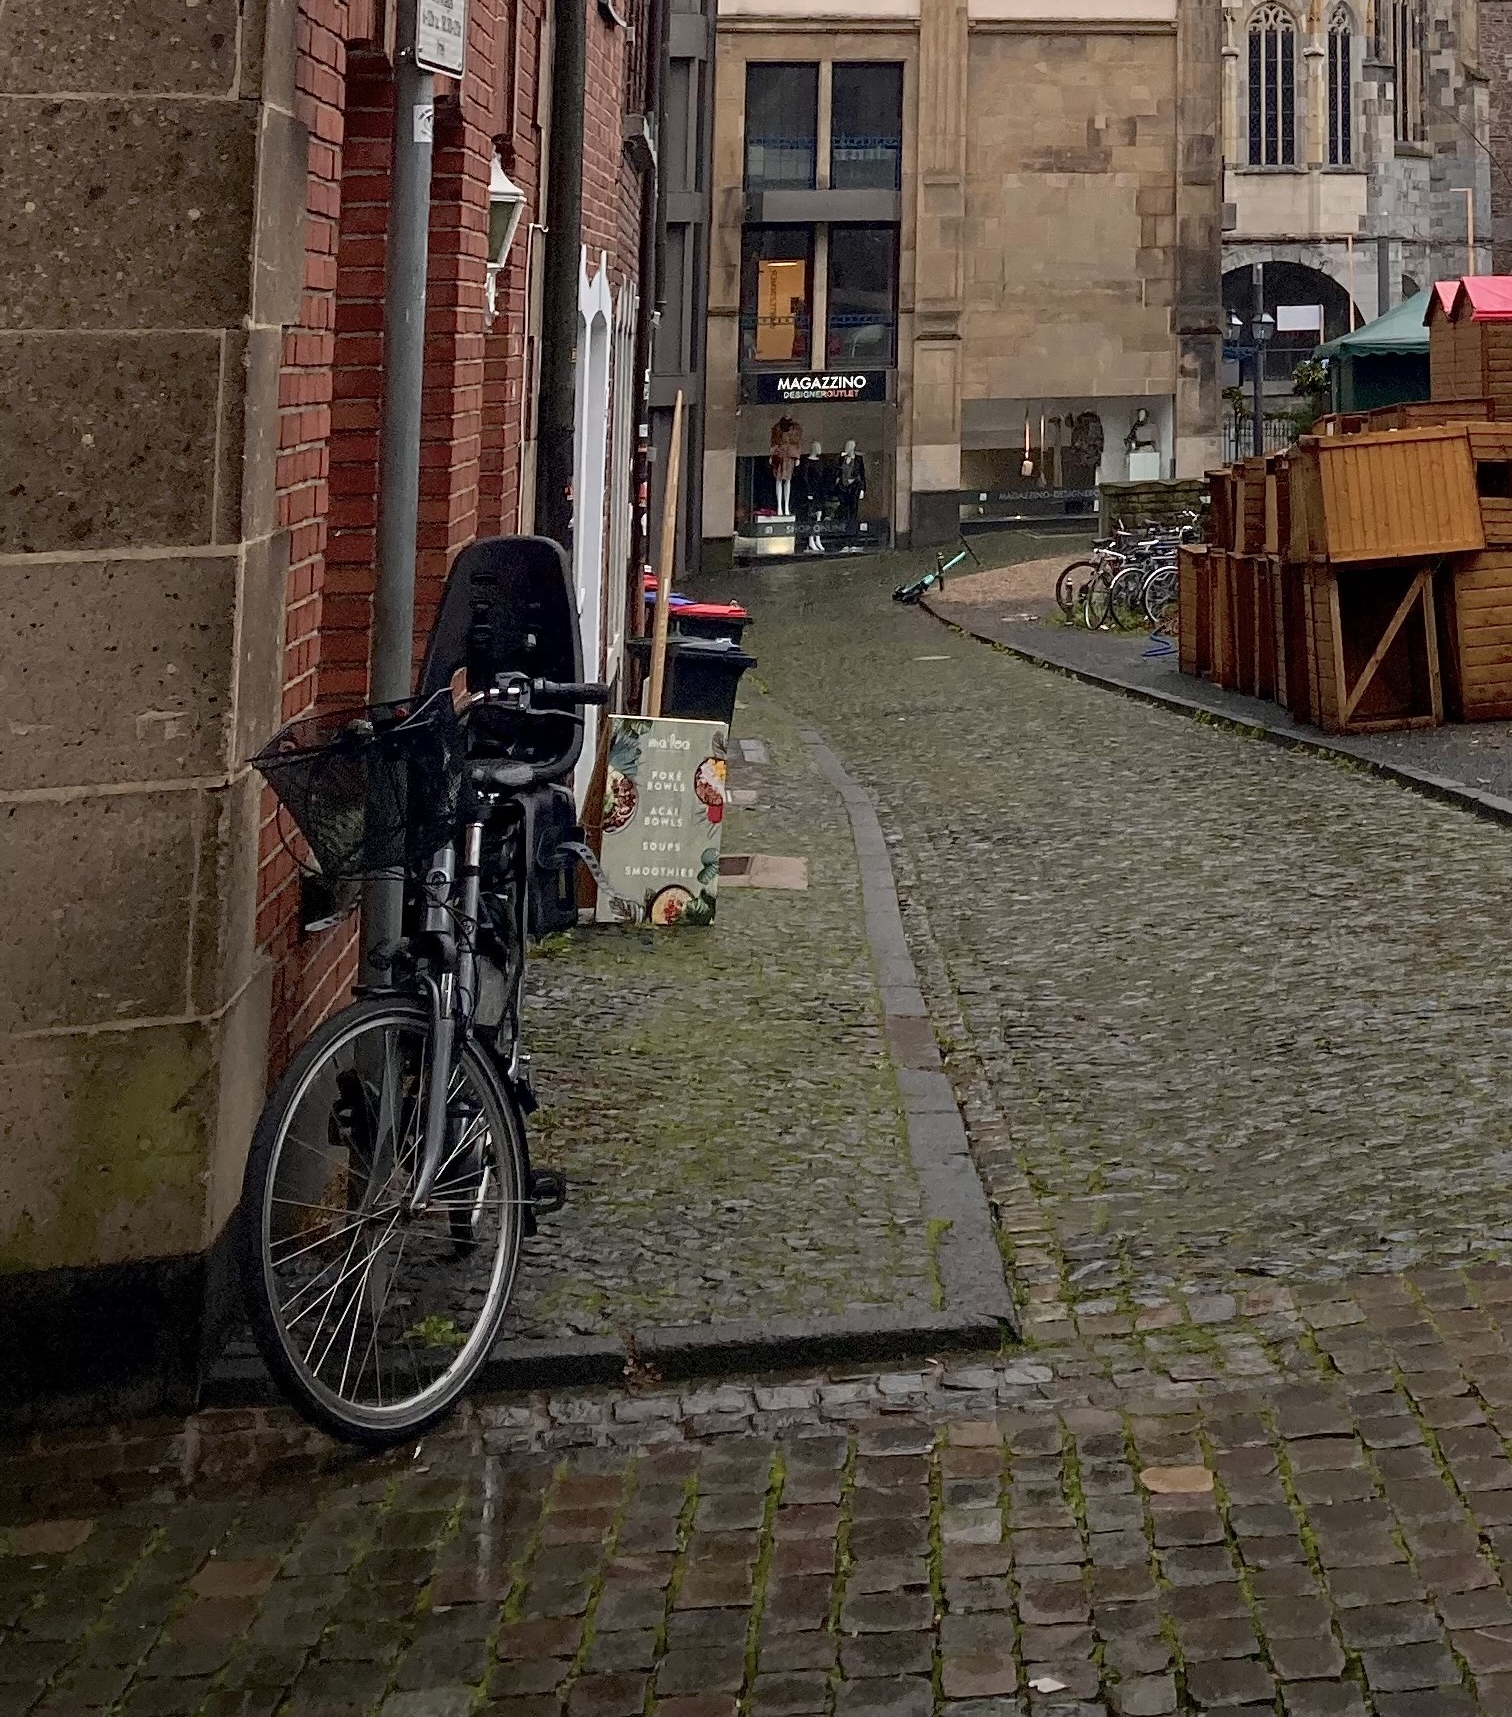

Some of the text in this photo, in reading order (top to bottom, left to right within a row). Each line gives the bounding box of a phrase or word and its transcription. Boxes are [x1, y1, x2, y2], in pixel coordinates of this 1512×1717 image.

[777, 375, 867, 390] MAGAZZINO
[646, 781, 686, 792] BOWLS
[643, 816, 683, 828] BOWLS
[641, 841, 681, 852] SOUPS
[624, 865, 695, 878] SMOOTHIES
